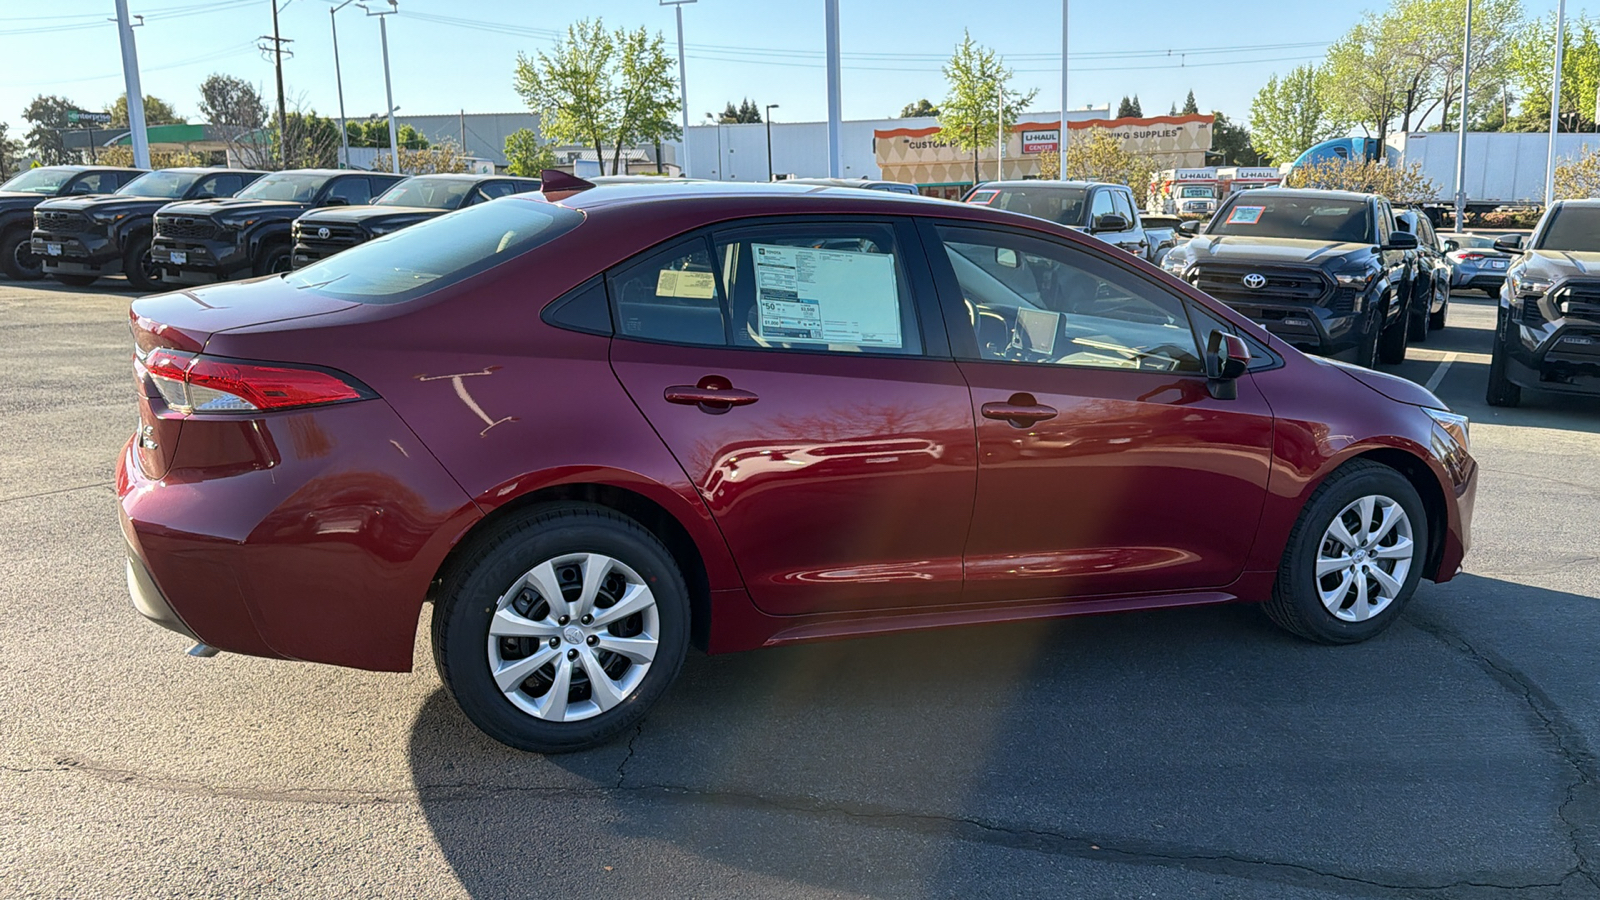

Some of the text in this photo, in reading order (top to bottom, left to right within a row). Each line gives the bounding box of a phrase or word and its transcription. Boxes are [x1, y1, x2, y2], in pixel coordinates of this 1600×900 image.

[69, 113, 111, 121] enterprise
[1107, 129, 1177, 140] VING SUPPLIES
[909, 140, 947, 150] CUSTOM
[765, 302, 776, 310] 50
